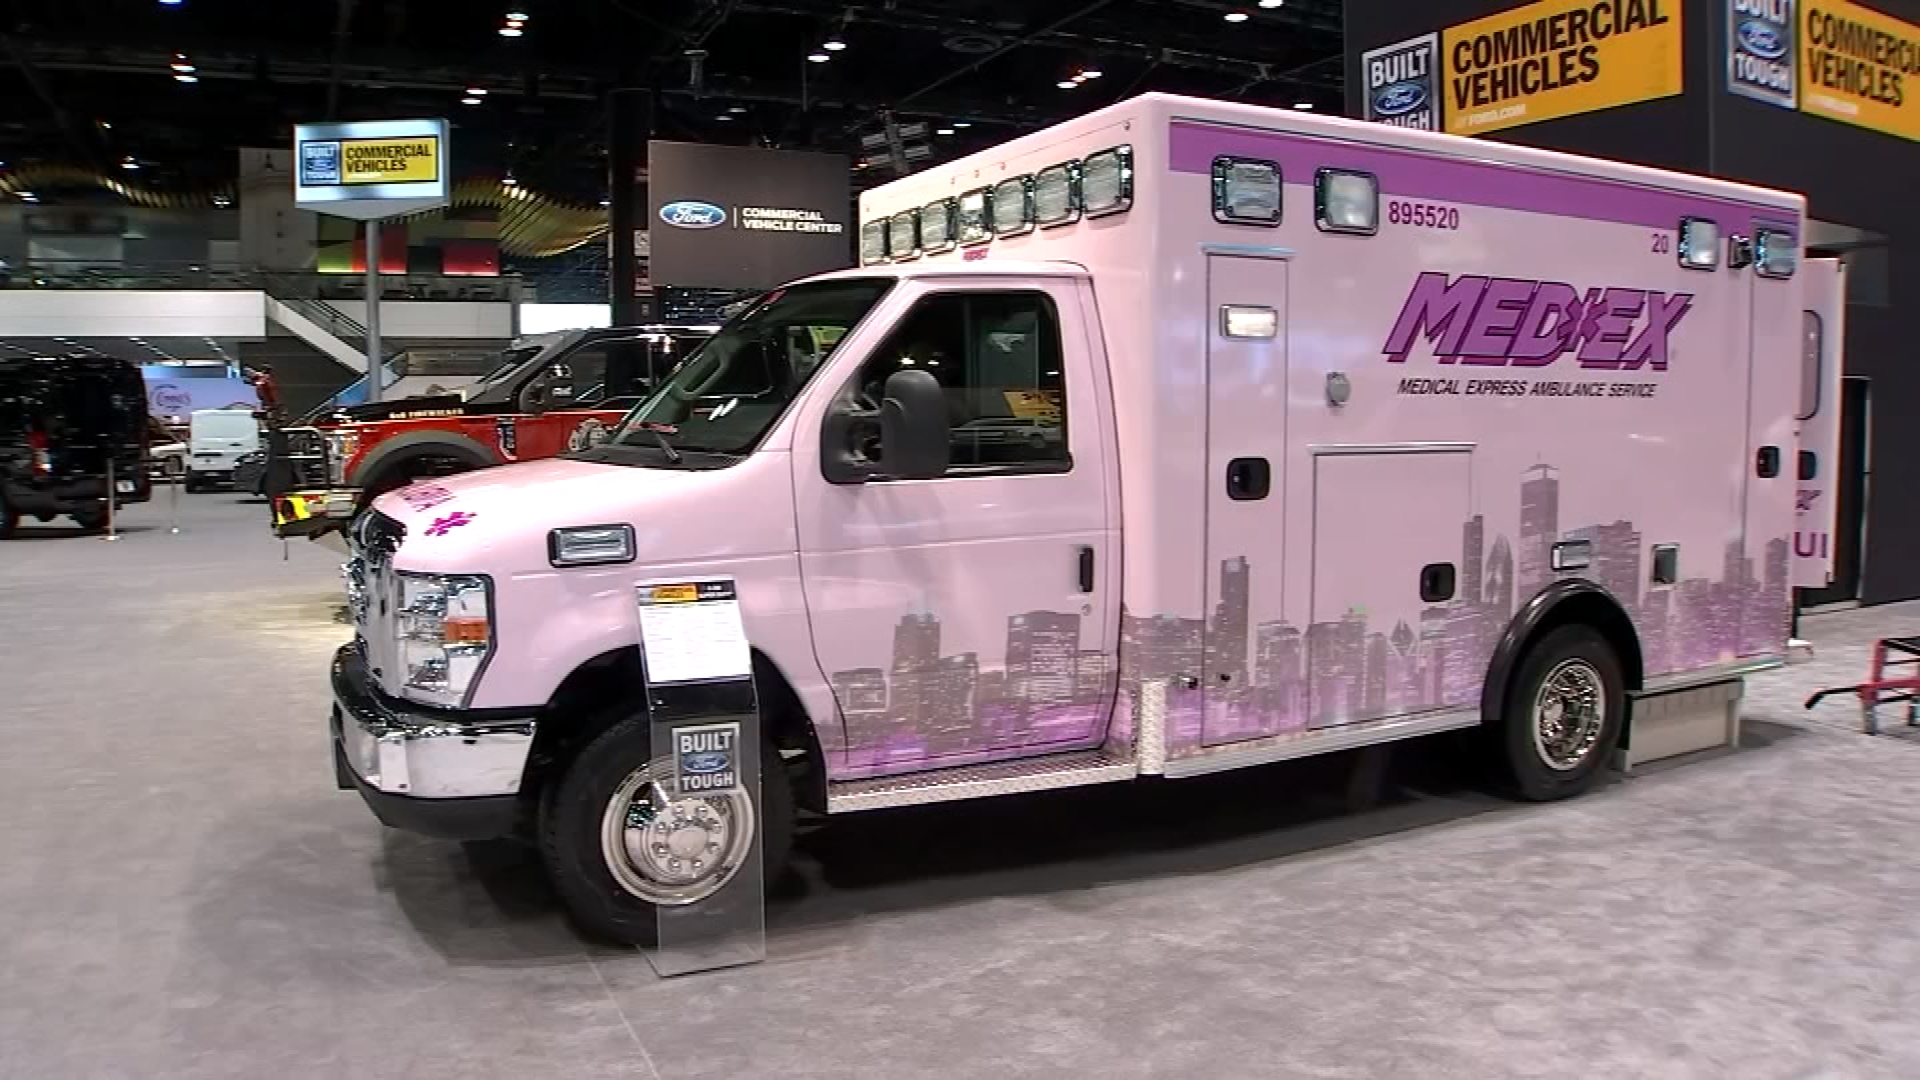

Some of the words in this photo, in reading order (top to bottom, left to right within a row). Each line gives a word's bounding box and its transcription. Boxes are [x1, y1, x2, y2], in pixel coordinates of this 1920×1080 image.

[1452, 0, 1669, 75] COMMERCIAL
[1808, 8, 1920, 75] COMMERCI
[1371, 48, 1429, 88] BUILT
[1453, 45, 1599, 111] VEHICLES
[1735, 52, 1792, 92] TOUGH
[1808, 47, 1903, 107] VEHICLES
[346, 143, 432, 159] COMMERCIAL
[346, 158, 407, 173] VEHICLES
[742, 207, 824, 221] COMMERCIAL
[1388, 201, 1460, 231] 895520
[742, 219, 794, 231] VEHICLE
[795, 222, 842, 233] CENTER
[1651, 233, 1670, 255] 20
[1398, 379, 1460, 396] MEDICAL
[1464, 380, 1528, 397] EXPRESS
[1529, 382, 1606, 397] AMBULANCE
[1607, 383, 1658, 398] SERVICE
[680, 731, 733, 753] BUILT
[682, 772, 735, 791] TOUGH
